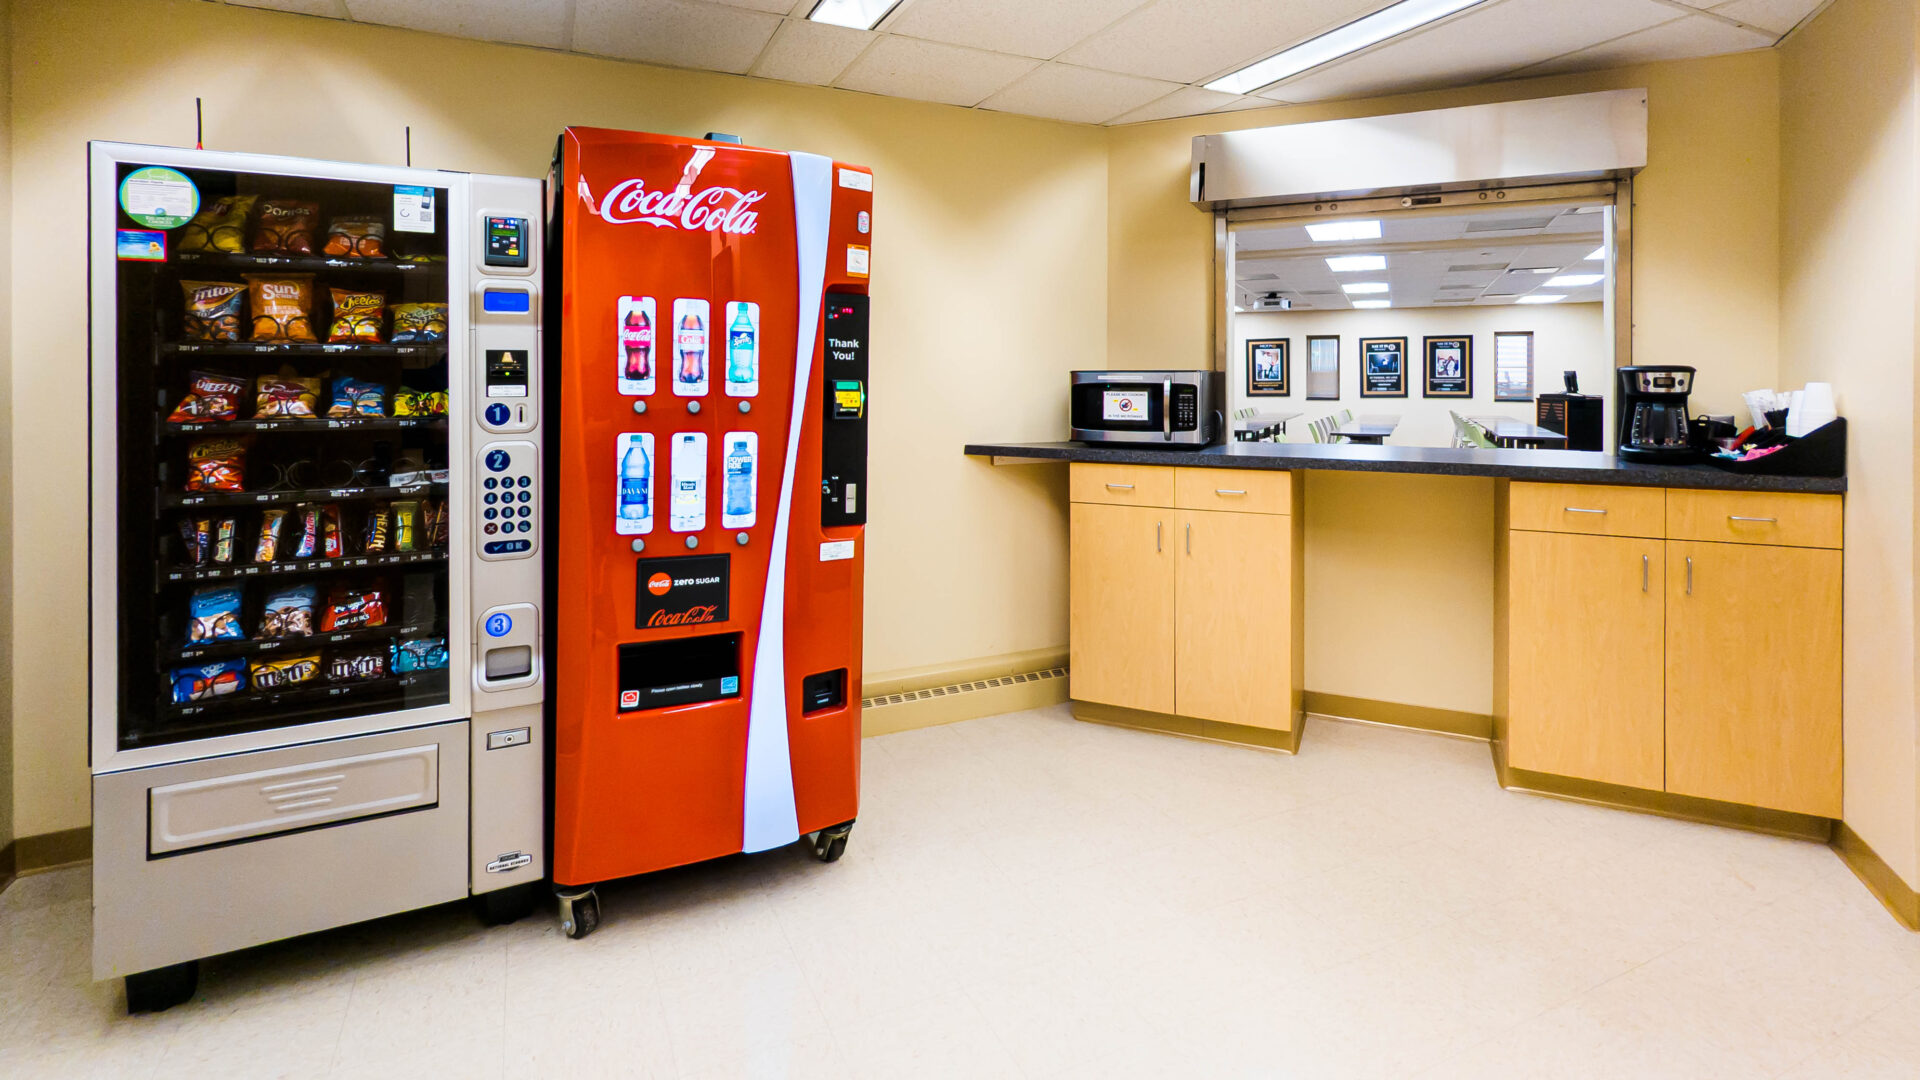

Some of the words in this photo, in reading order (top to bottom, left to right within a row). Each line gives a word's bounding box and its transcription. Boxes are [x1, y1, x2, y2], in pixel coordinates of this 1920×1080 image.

[600, 178, 767, 234] Coca-Cola
[262, 284, 300, 300] Sun
[828, 339, 859, 348] Thank
[833, 351, 855, 360] You!
[493, 407, 500, 421] 1
[493, 454, 503, 468] 2
[488, 480, 493, 488] 1
[505, 479, 511, 487] 2
[522, 477, 527, 486] 3
[505, 494, 511, 502] 5
[522, 492, 527, 501] 6
[505, 508, 511, 516] 8
[522, 507, 527, 515] 9
[505, 523, 511, 531] 0
[506, 542, 523, 550] OK
[673, 578, 695, 587] zero
[695, 577, 720, 585] SUGAR
[647, 604, 719, 627] Coca-Cola
[495, 618, 504, 632] 3
